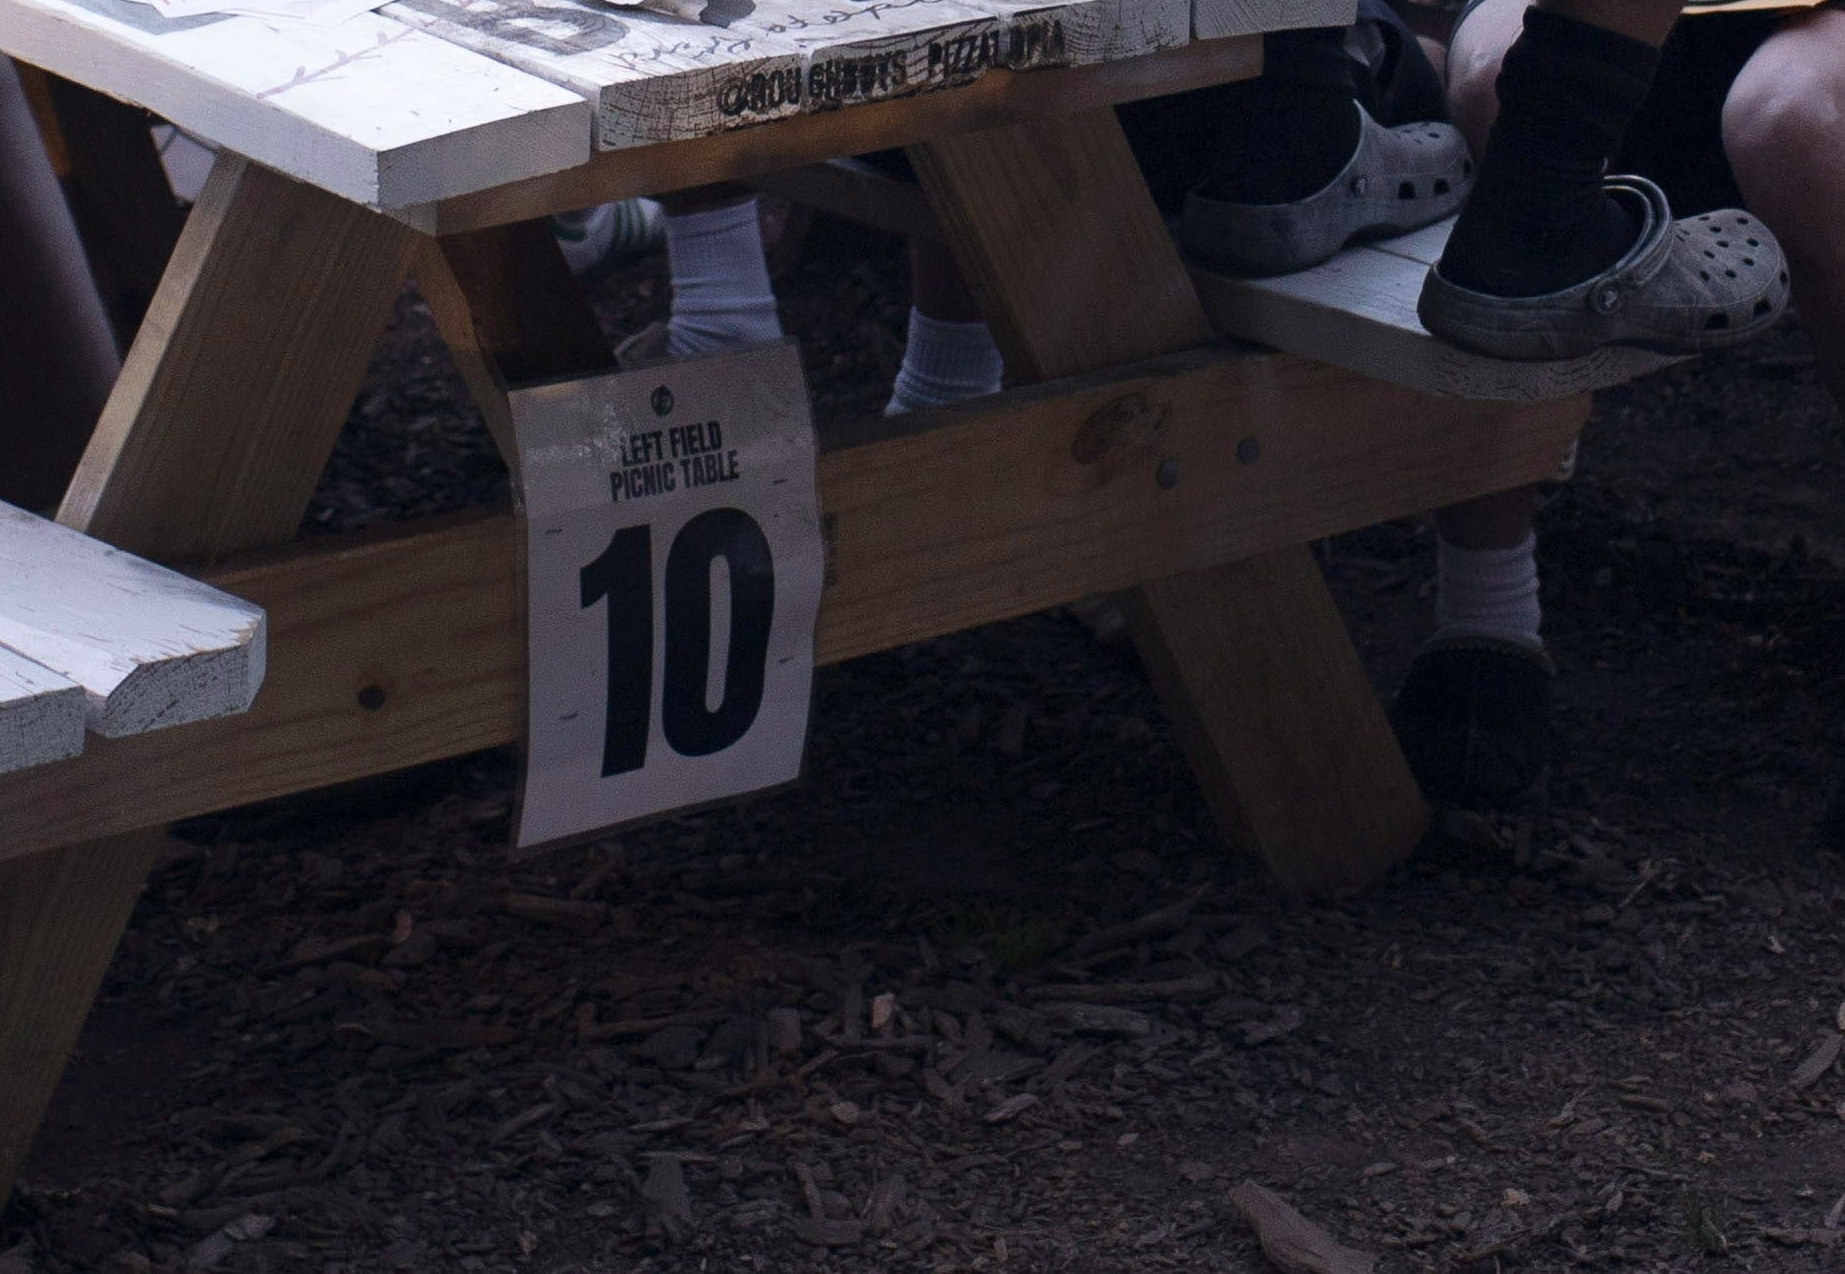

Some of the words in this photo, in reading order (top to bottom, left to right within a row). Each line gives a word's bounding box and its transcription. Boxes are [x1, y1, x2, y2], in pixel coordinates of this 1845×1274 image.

[619, 430, 663, 468] LEFT
[668, 420, 723, 458] FIELD
[609, 462, 677, 503] PICNIC
[680, 450, 741, 489] TABLE
[579, 507, 775, 778] 10
